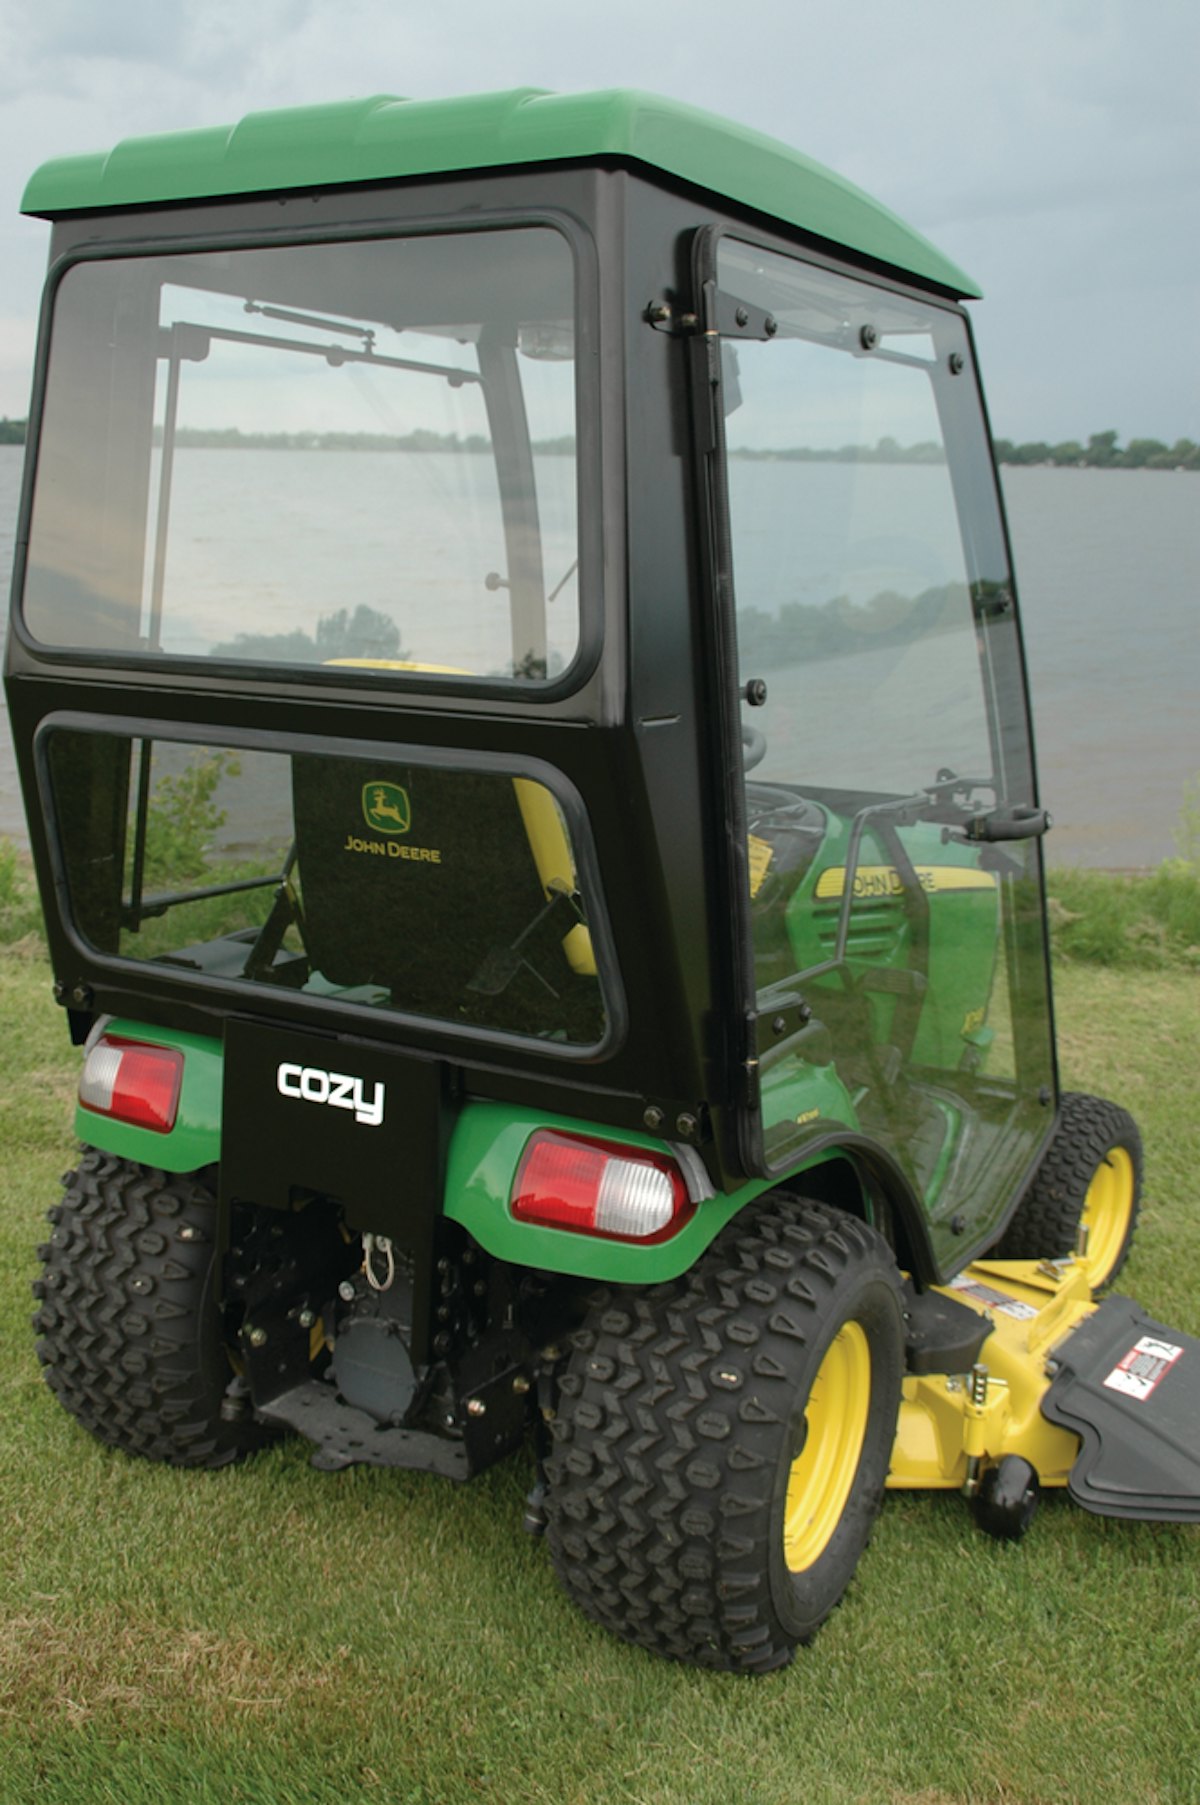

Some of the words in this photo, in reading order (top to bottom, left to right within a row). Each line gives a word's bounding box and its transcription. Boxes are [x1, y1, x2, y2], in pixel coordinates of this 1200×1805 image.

[344, 835, 386, 856] JOHN
[387, 841, 442, 864] DEERE
[853, 873, 889, 895] OHN
[277, 1062, 385, 1126] cozy
